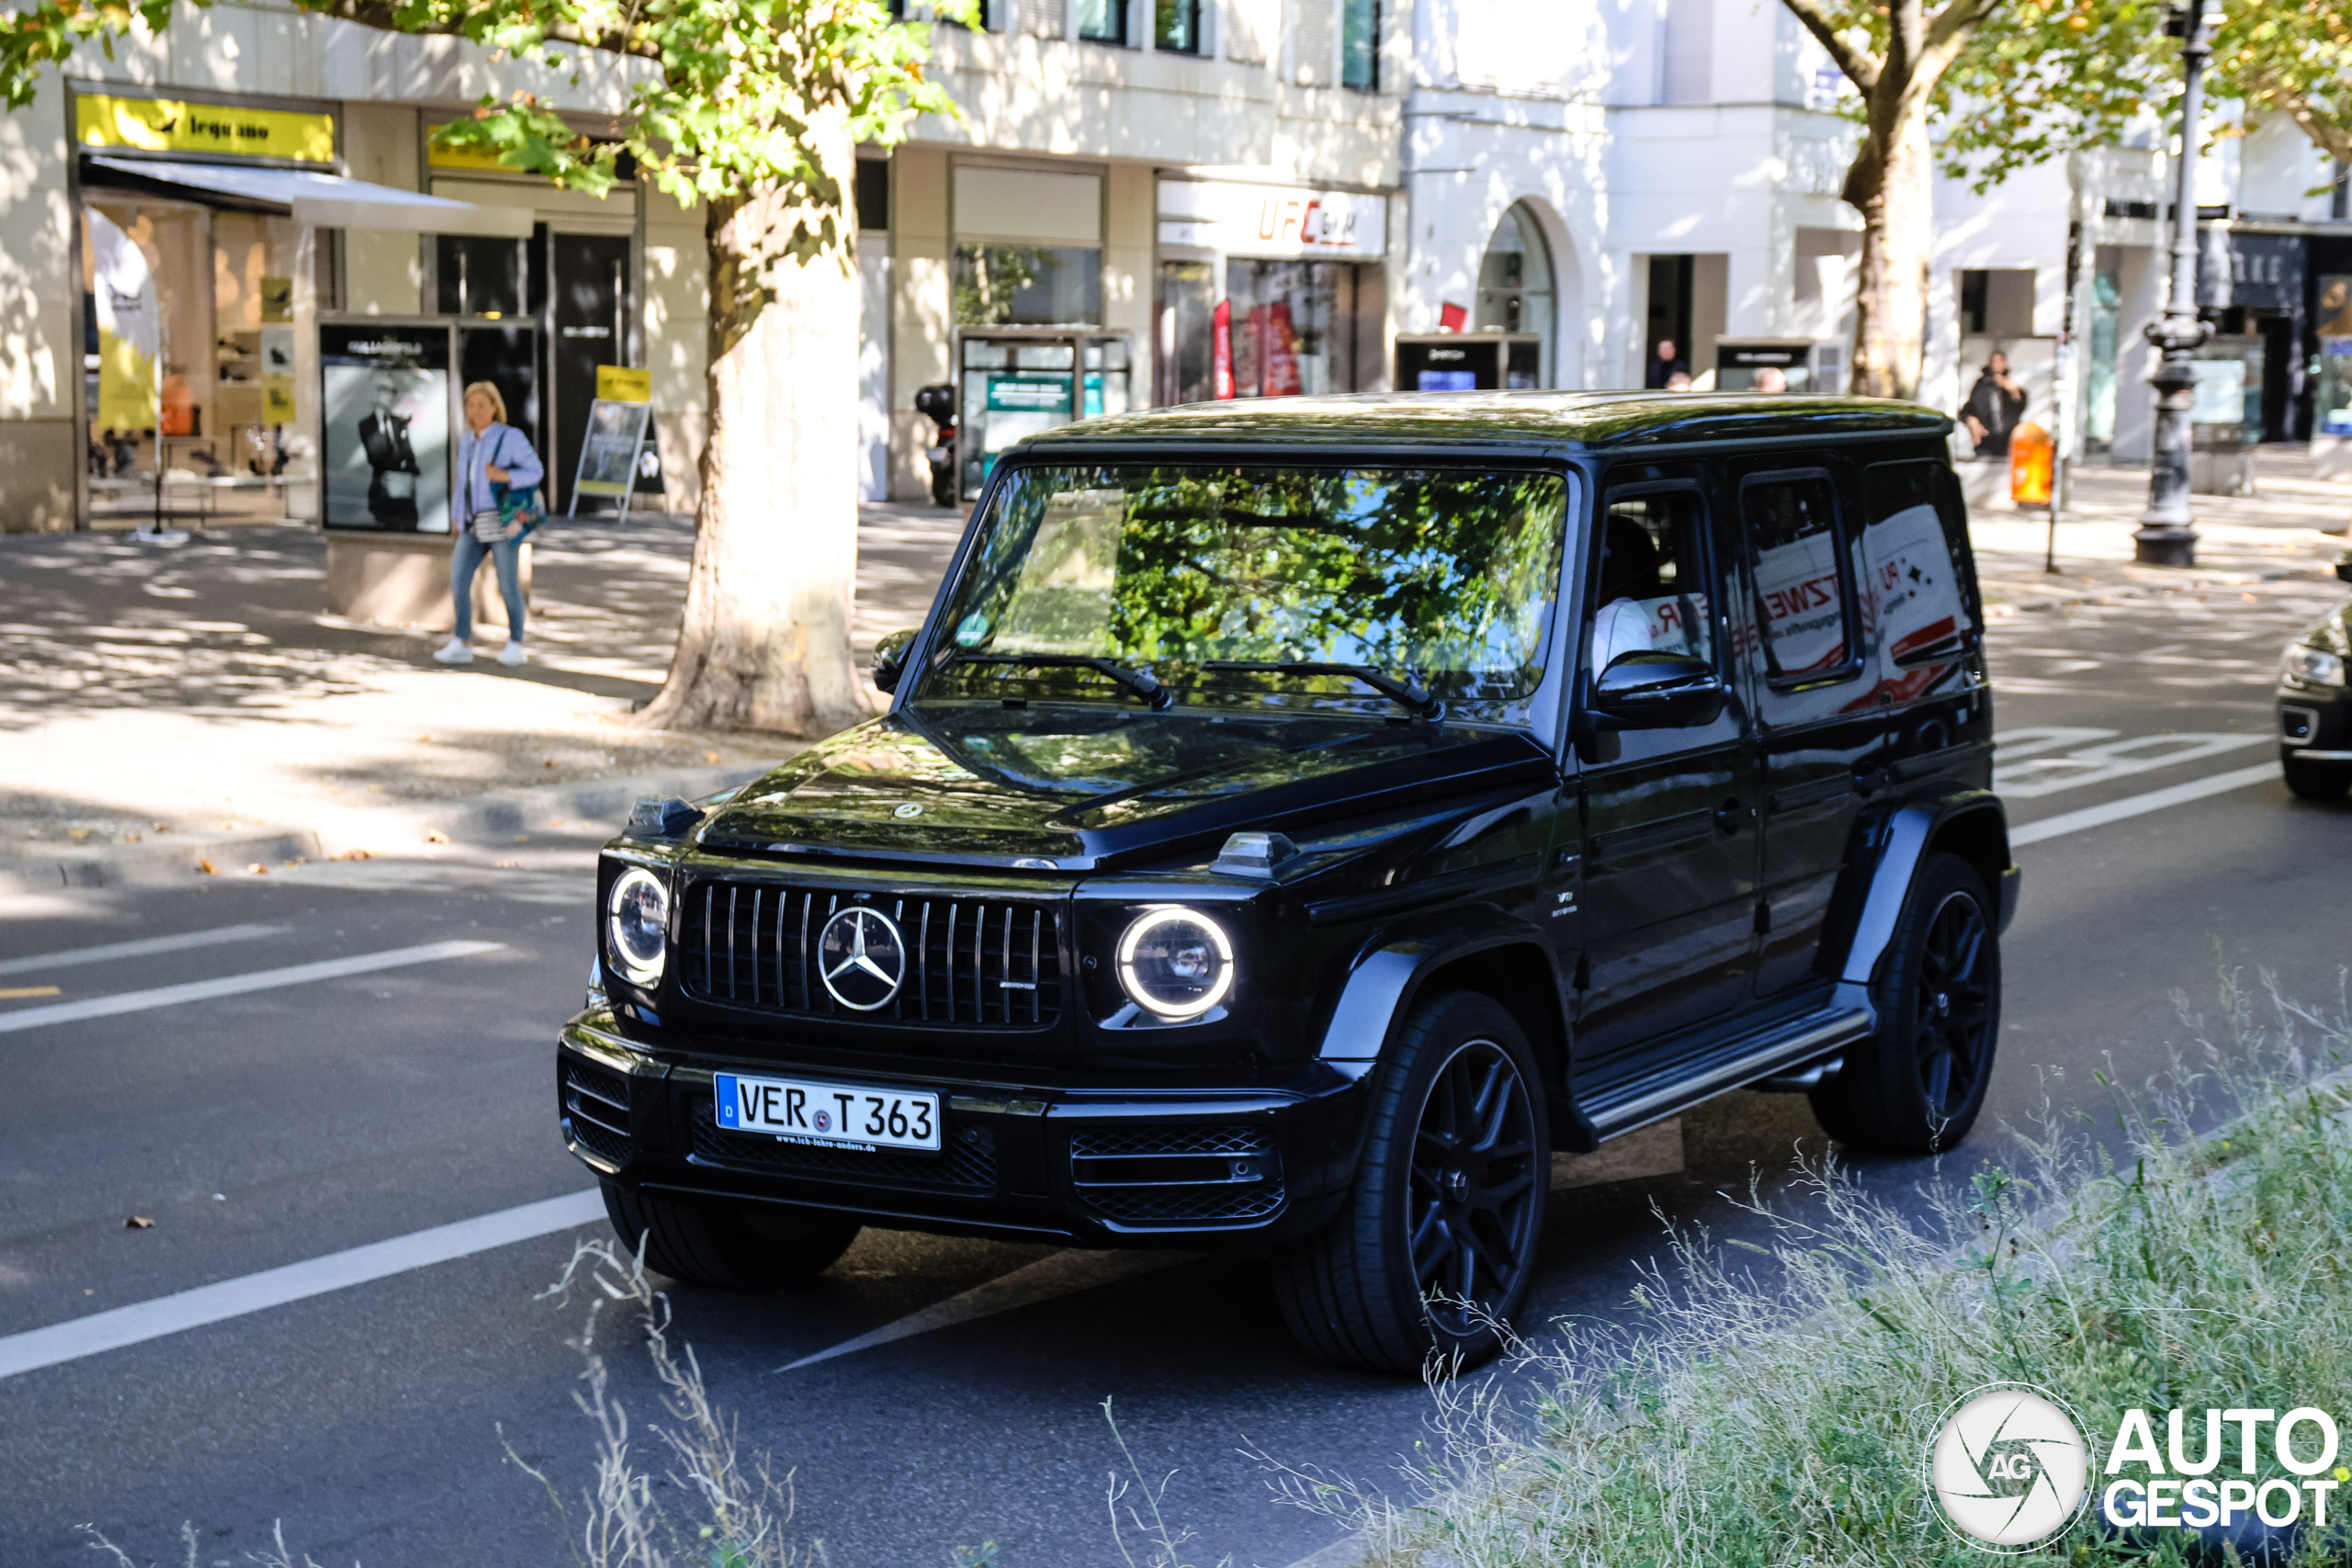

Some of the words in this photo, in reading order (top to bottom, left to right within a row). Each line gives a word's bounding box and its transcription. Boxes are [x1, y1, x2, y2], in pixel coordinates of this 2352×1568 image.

[1259, 198, 1321, 243] UFC
[724, 1105, 733, 1119] D
[740, 1083, 808, 1128] VER
[833, 1093, 854, 1133] T
[865, 1097, 932, 1140] 363
